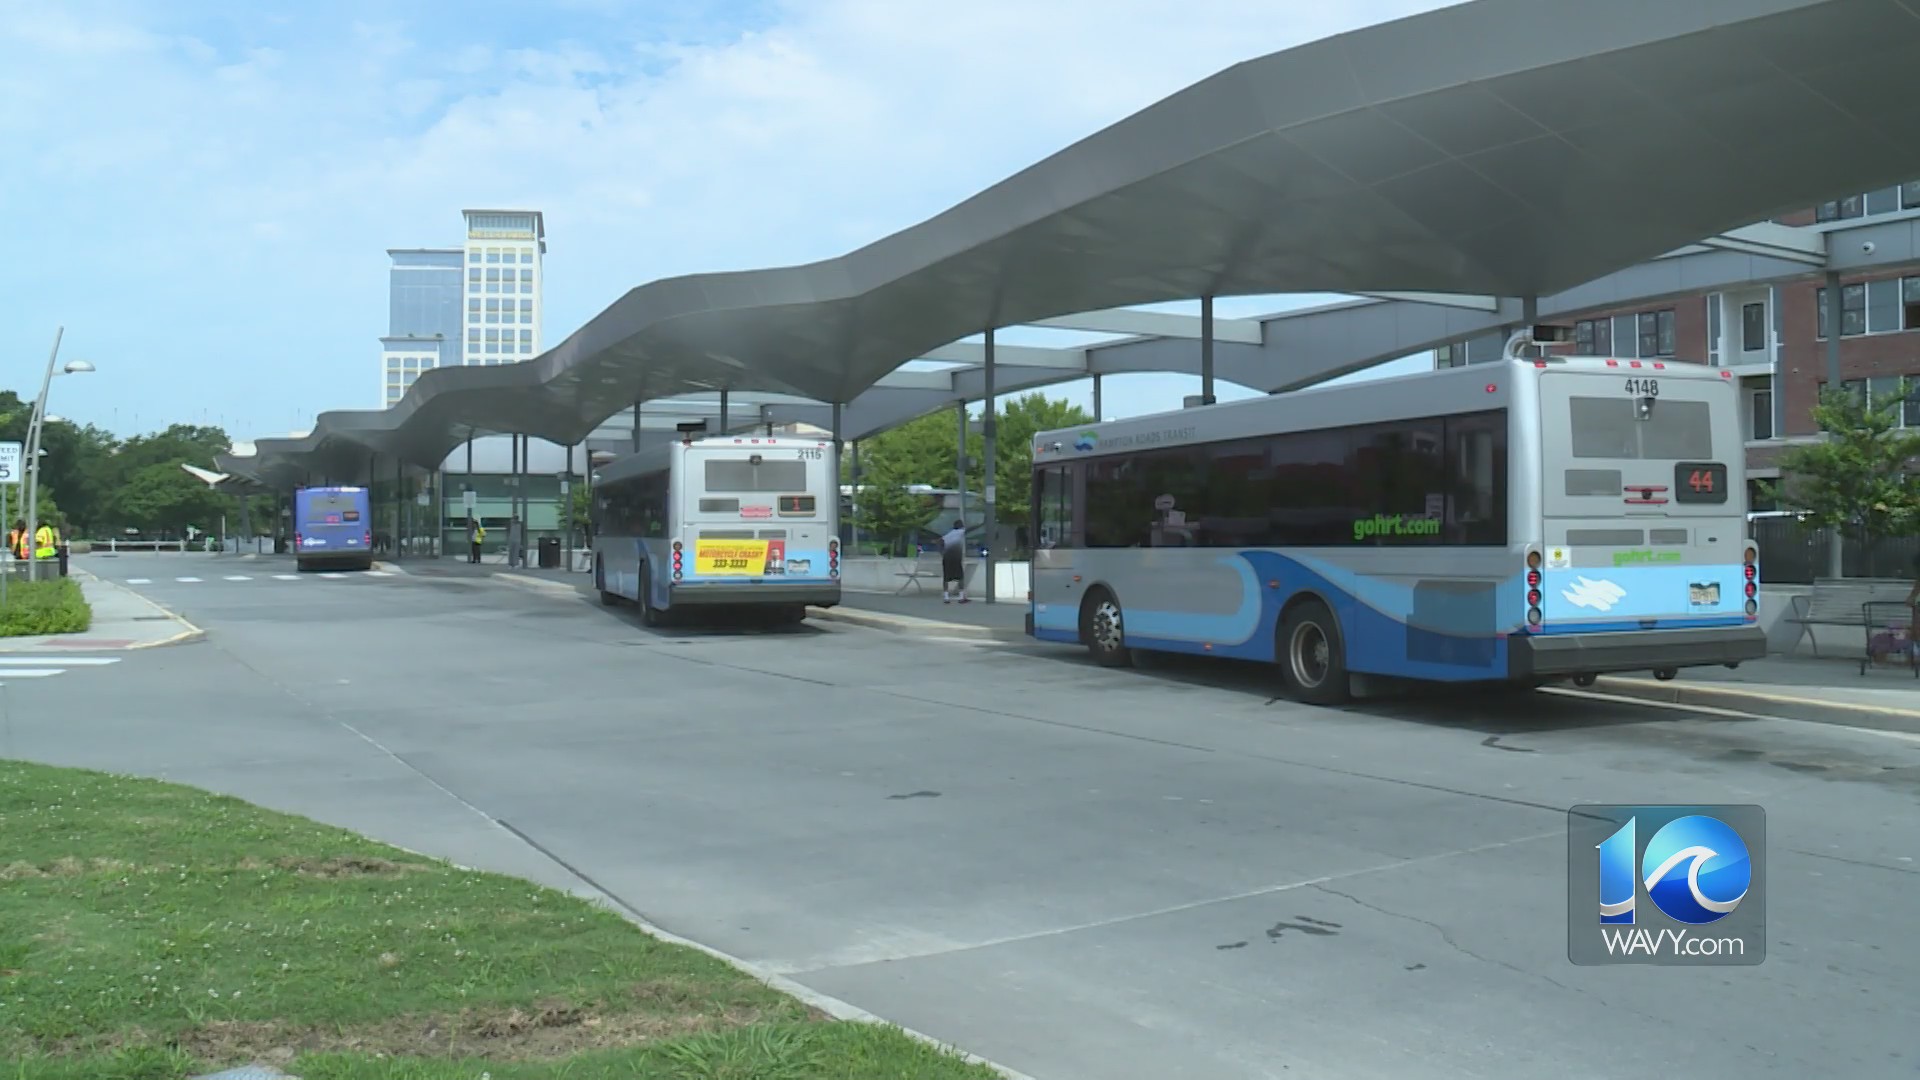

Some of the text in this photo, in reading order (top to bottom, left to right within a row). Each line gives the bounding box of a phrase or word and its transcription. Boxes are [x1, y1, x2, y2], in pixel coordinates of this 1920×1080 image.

[1624, 379, 1660, 397] 4148
[797, 448, 822, 460] 2115
[1688, 470, 1714, 493] 44
[1353, 513, 1440, 541] gohrt.com
